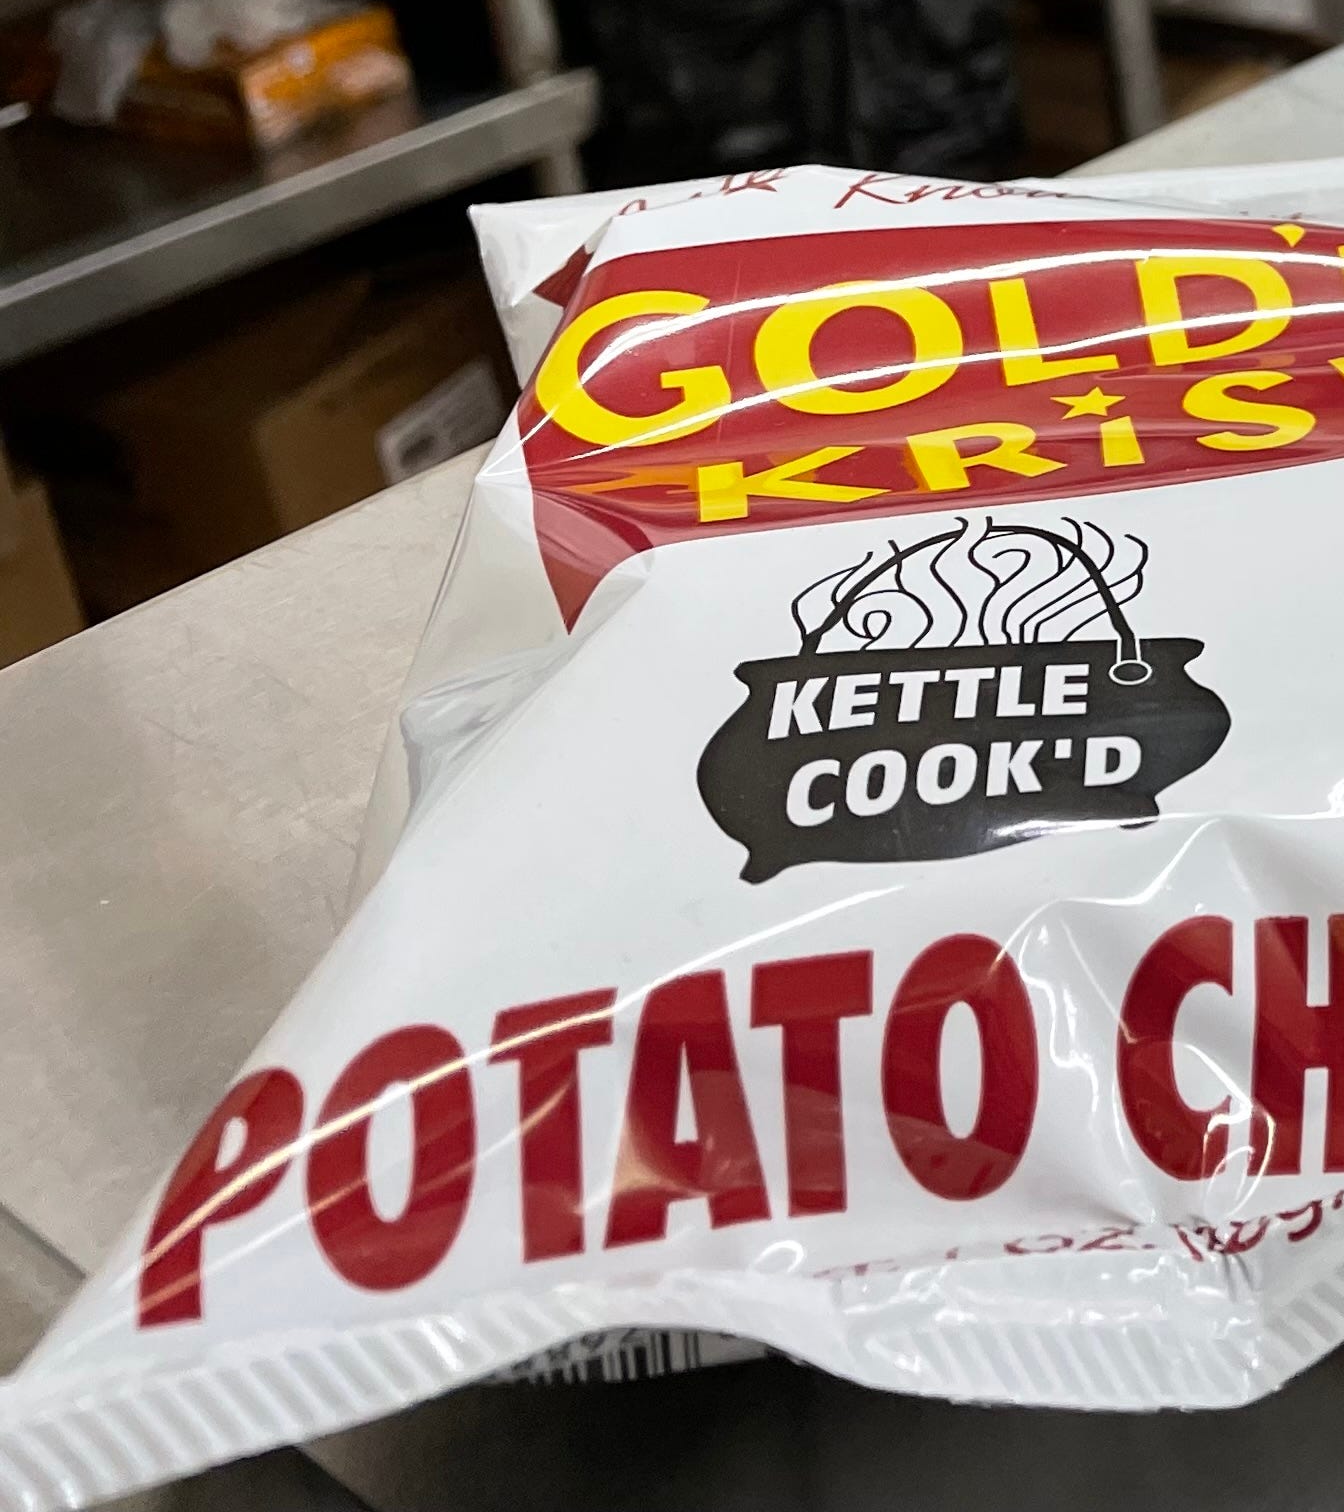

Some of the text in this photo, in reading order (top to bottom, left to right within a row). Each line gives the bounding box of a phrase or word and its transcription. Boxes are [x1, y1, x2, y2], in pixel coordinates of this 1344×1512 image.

[766, 663, 1091, 744] KETTLE
[784, 734, 1145, 830] COOK'D
[134, 927, 1042, 1330] POTATO
